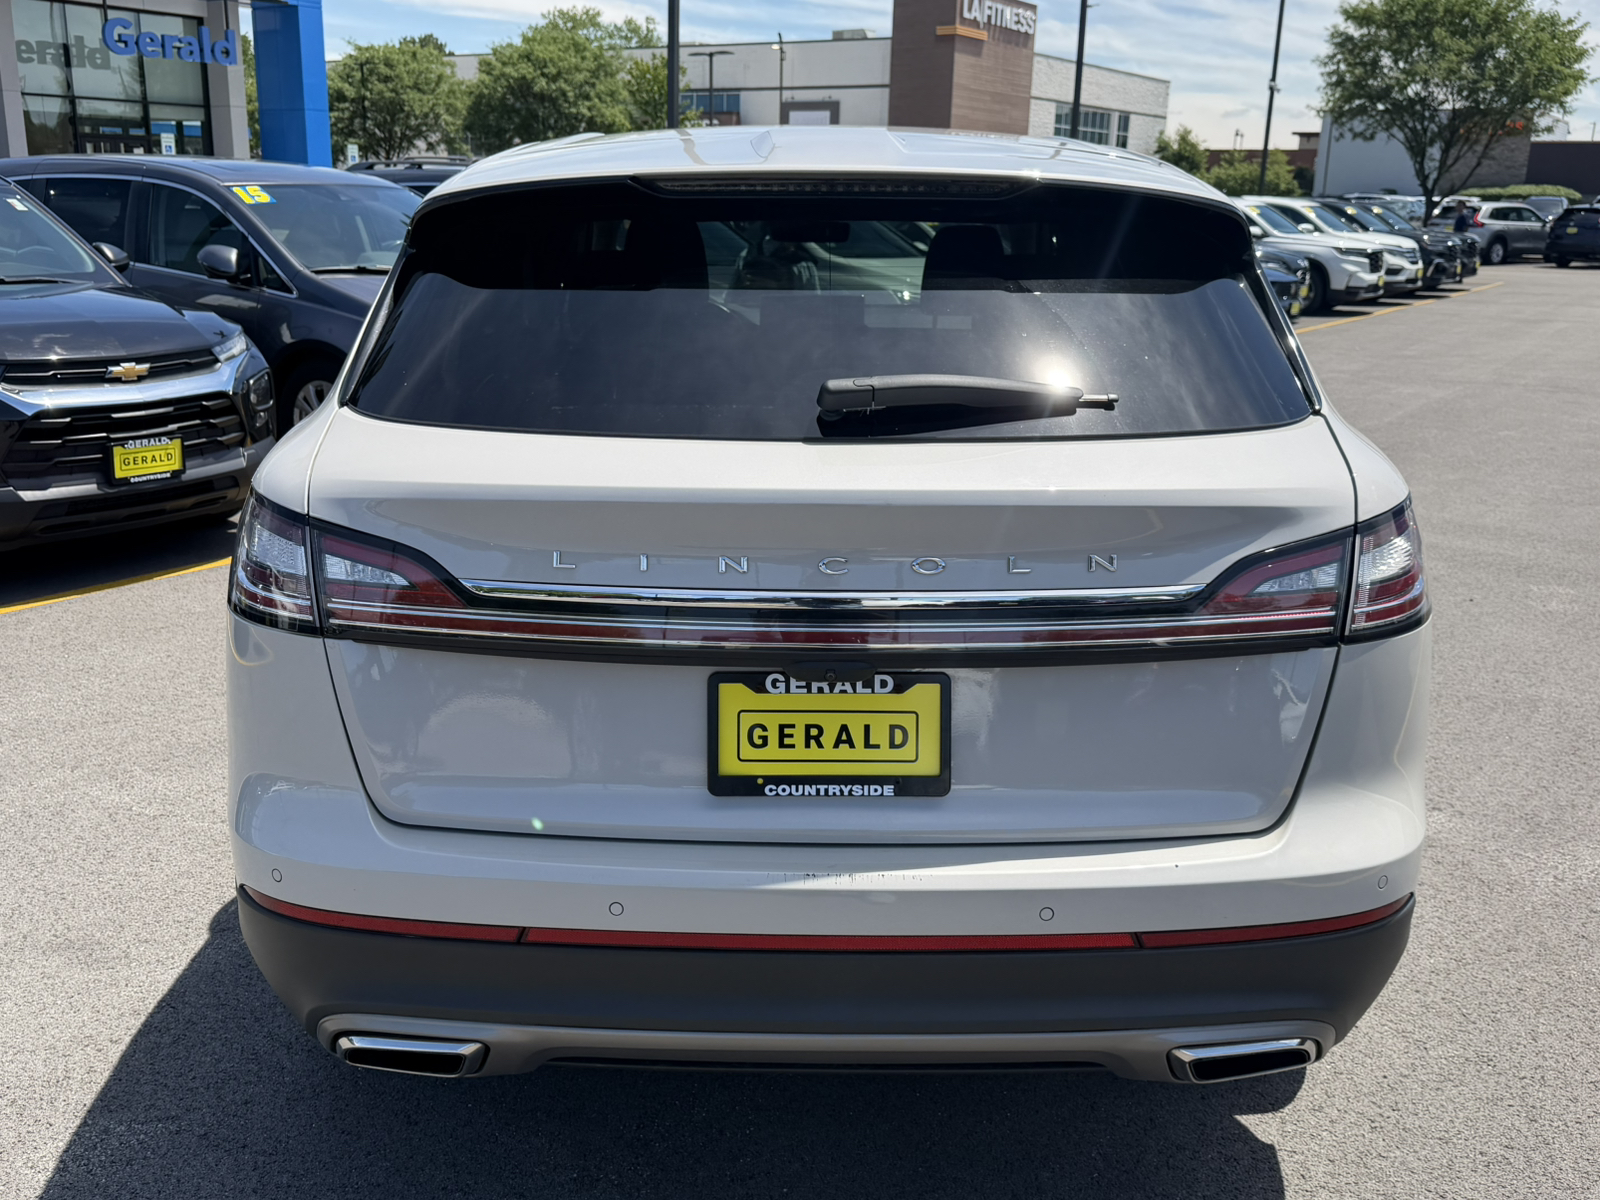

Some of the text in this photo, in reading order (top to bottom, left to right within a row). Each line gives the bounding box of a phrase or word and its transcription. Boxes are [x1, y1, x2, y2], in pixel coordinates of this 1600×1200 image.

[984, 1, 1036, 35] FITNESS
[102, 17, 238, 66] Gerald
[232, 185, 271, 204] 15
[127, 436, 169, 449] GERALD
[122, 452, 174, 467] GERALD
[553, 550, 1118, 575] LINCOLN
[746, 723, 909, 749] GERALD
[764, 784, 895, 796] COUNTRYSIDE
